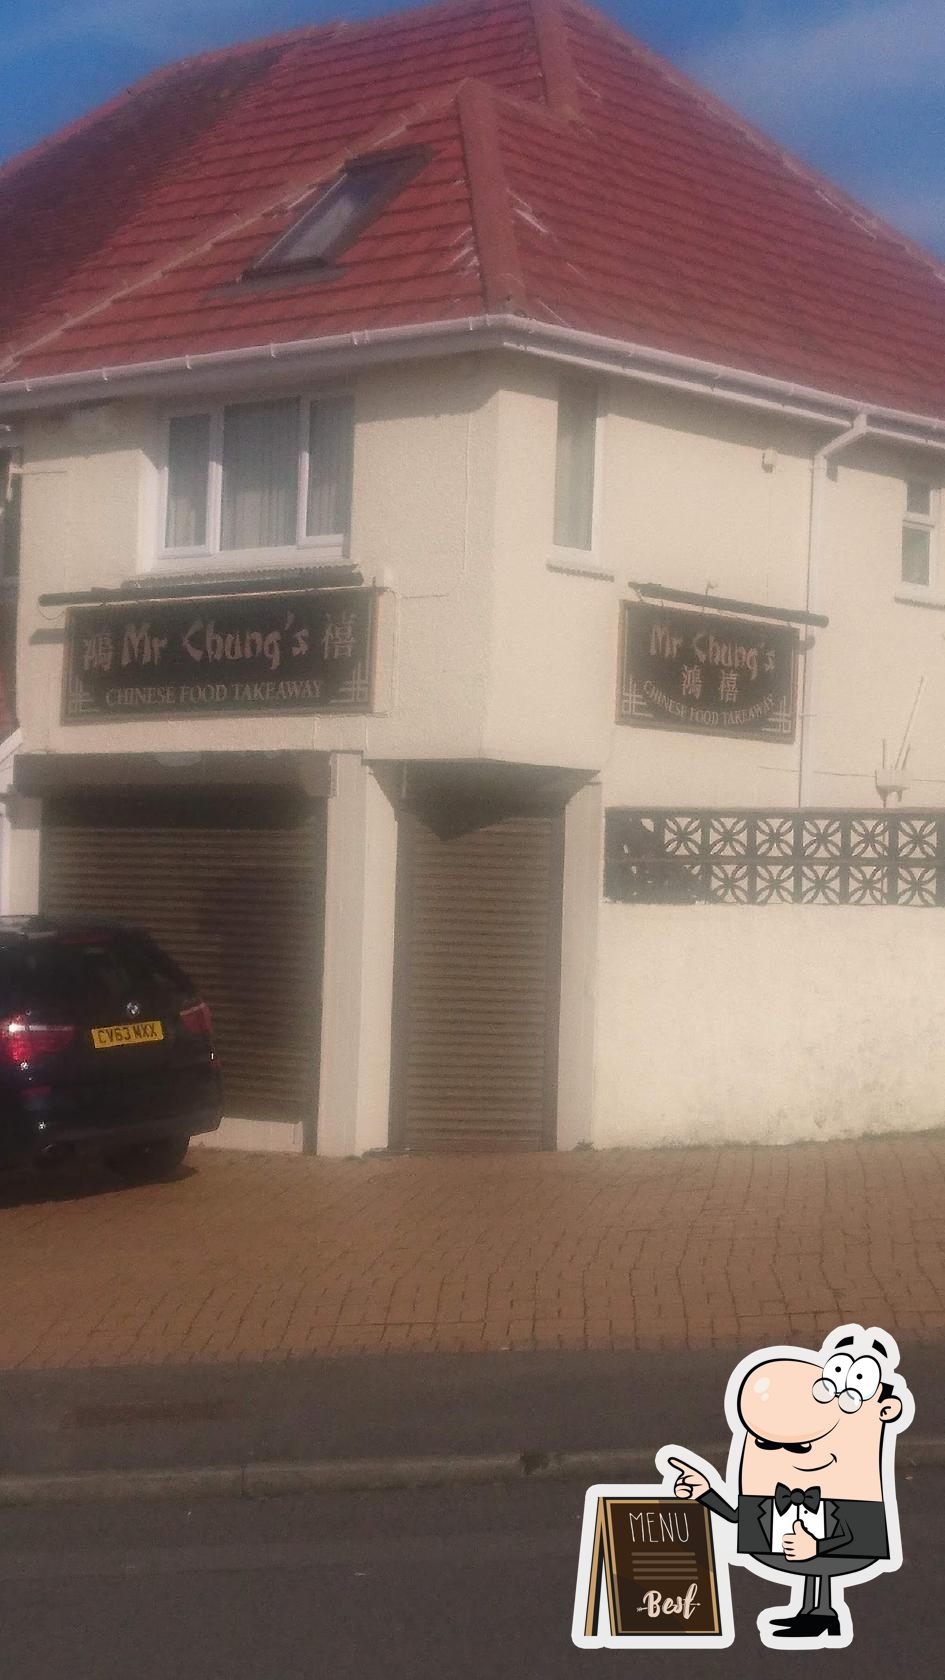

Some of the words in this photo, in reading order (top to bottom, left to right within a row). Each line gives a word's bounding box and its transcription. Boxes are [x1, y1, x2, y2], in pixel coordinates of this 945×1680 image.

[121, 622, 168, 667] Mr
[182, 611, 309, 671] Chung's
[649, 624, 684, 659] Mr
[692, 633, 776, 681] Chung's
[105, 685, 178, 706] CHINESE
[180, 683, 229, 703] FOOD
[231, 679, 324, 702] TAKEAWAY
[643, 680, 686, 719] CHINESE
[689, 706, 719, 726] FOOD
[722, 692, 776, 726] TAKEAWAY
[98, 1027, 131, 1044] CV63
